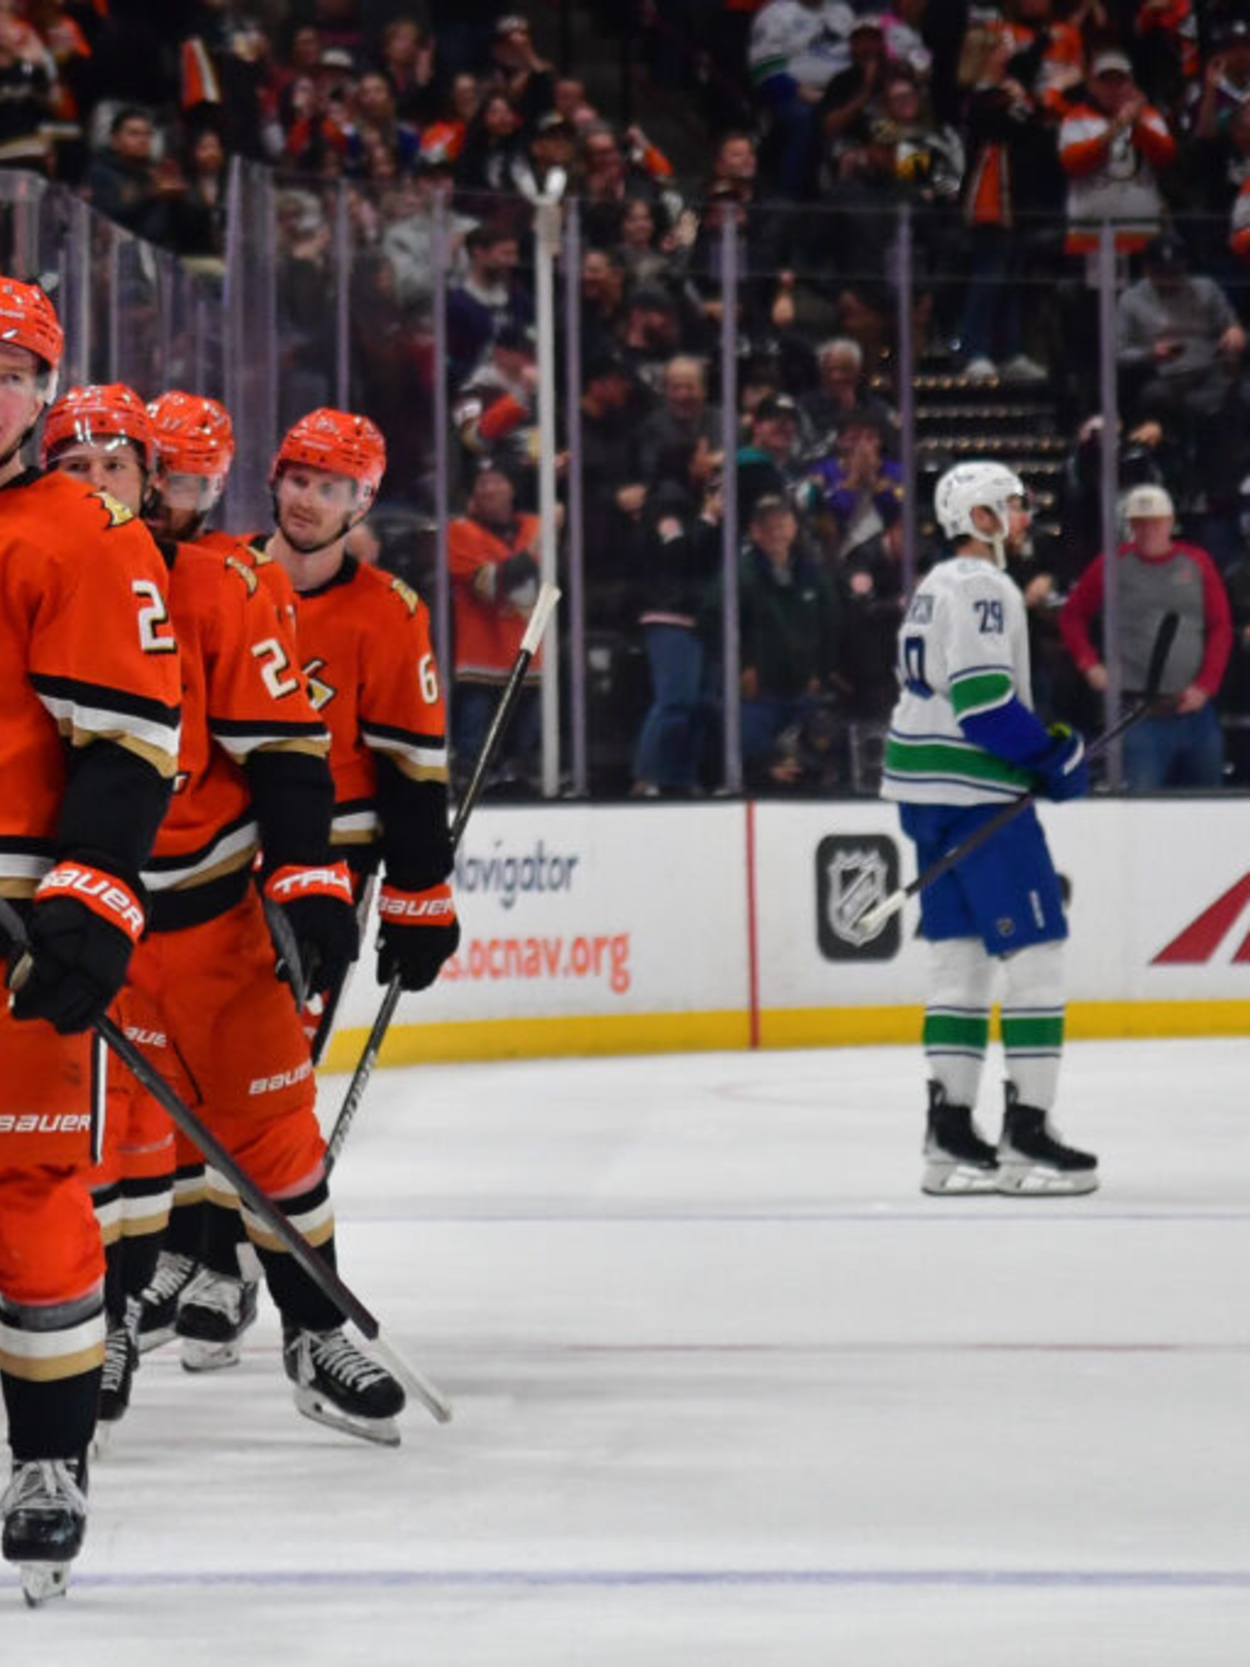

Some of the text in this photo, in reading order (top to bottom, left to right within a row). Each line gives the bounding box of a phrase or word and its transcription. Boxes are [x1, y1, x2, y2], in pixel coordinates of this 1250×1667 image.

[132, 579, 175, 651] 2
[973, 601, 1005, 634] 29
[251, 638, 298, 699] 2
[124, 1026, 167, 1047] AUE
